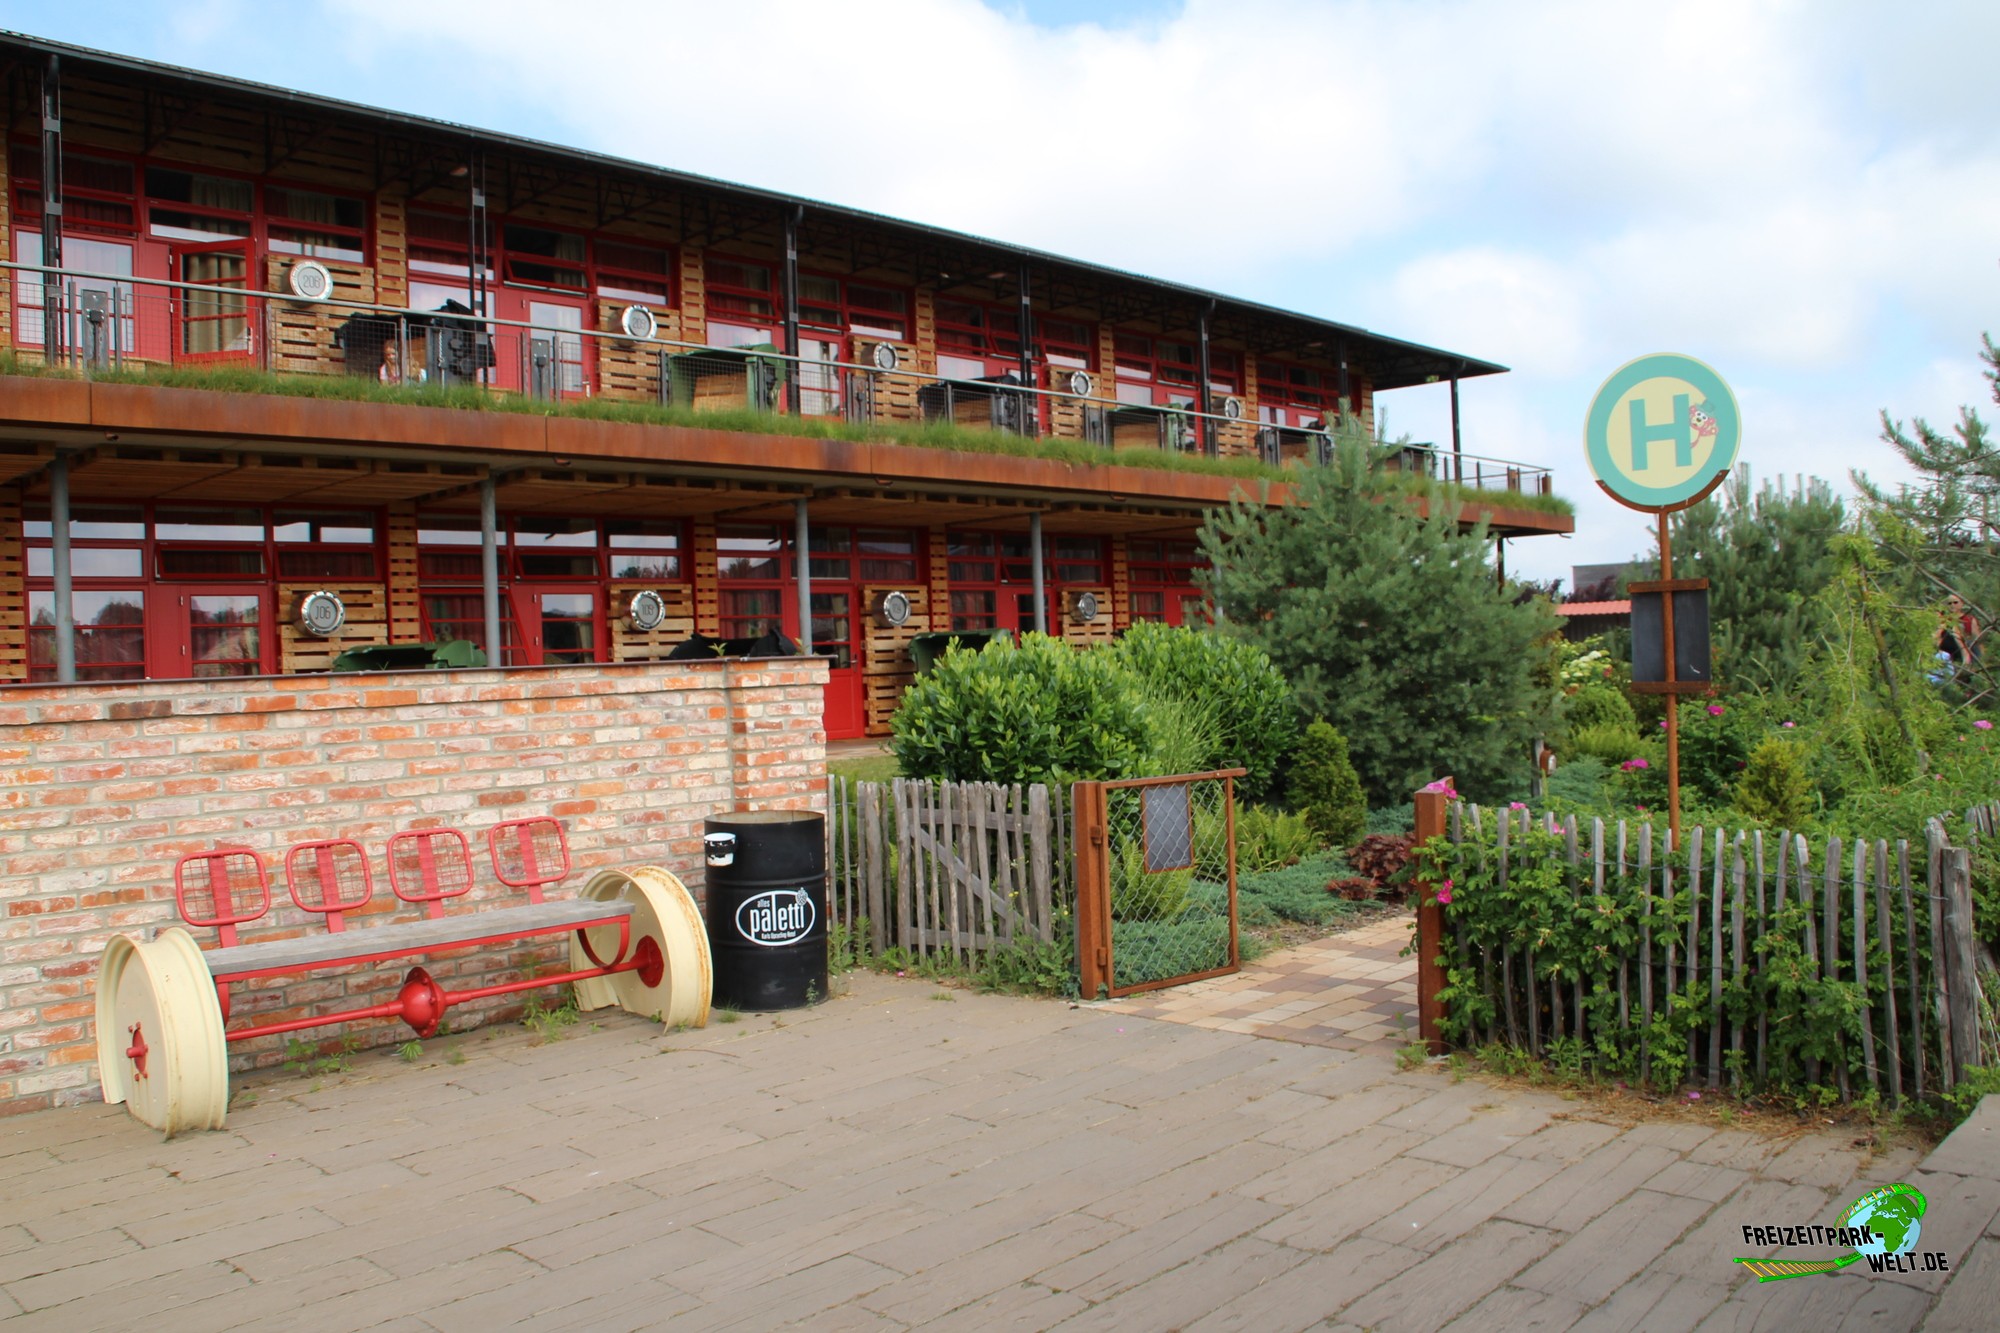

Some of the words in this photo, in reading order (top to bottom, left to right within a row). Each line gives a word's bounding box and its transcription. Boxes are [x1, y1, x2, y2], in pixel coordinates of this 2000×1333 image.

[302, 274, 321, 289] 206
[1629, 393, 1693, 471] H
[315, 605, 331, 620] 106
[757, 898, 770, 908] alles
[749, 895, 805, 938] paletti
